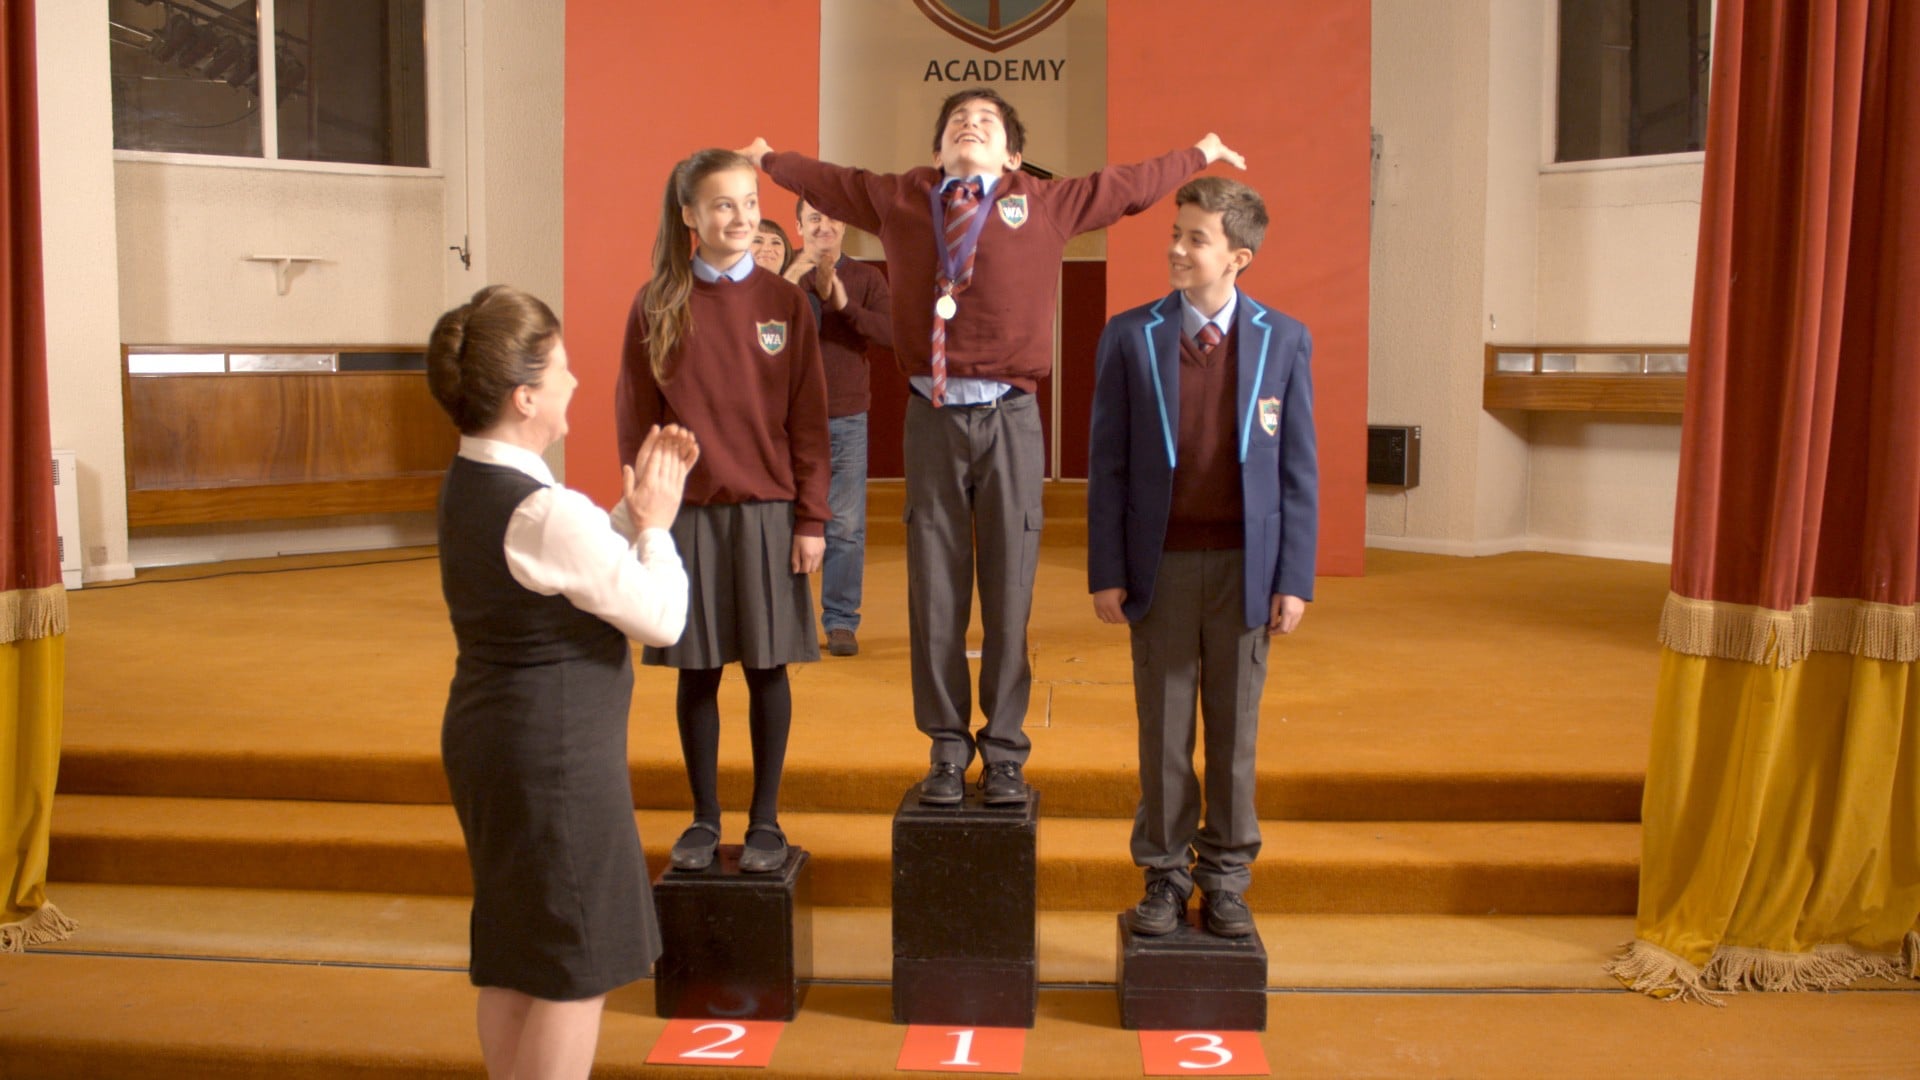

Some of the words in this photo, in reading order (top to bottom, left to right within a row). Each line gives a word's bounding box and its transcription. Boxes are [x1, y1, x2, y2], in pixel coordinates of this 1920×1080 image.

[924, 59, 1066, 82] ACADEMY
[1003, 207, 1024, 218] WA
[762, 333, 782, 345] WA
[679, 1022, 747, 1059] 2
[939, 1029, 982, 1066] 1
[1173, 1033, 1233, 1069] 3
